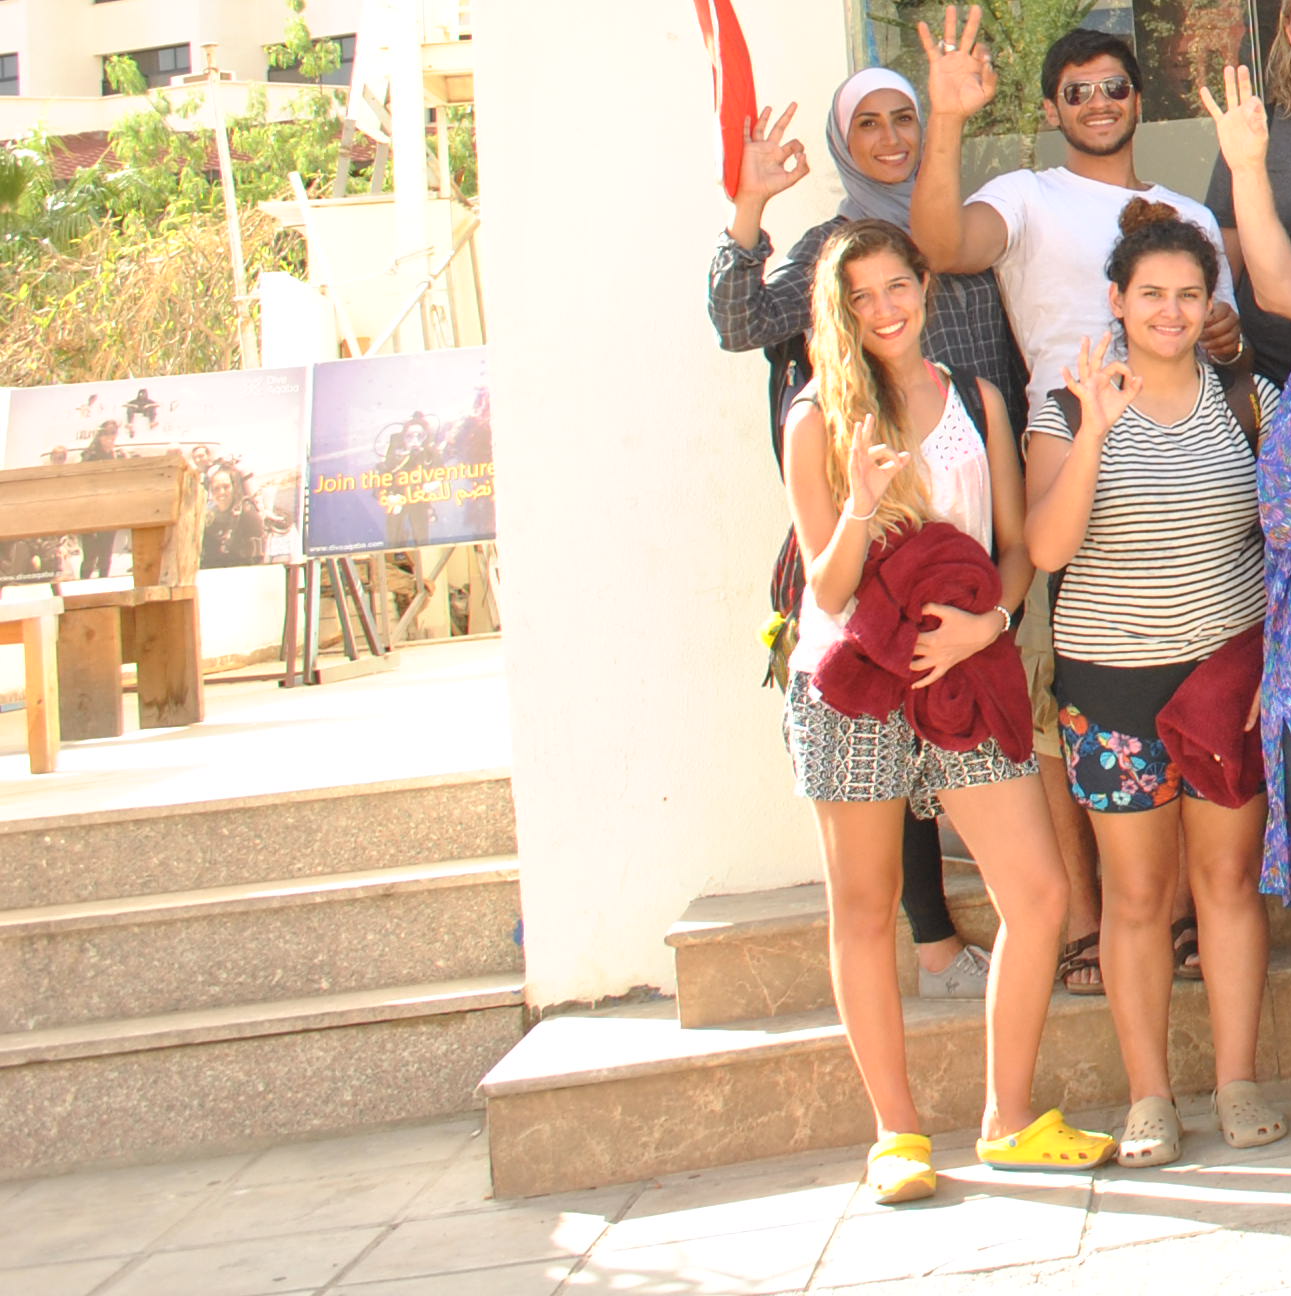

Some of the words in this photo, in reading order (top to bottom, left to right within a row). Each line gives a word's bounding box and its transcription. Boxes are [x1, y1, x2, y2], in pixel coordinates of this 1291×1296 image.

[314, 473, 356, 494] Join
[361, 471, 393, 489] the
[399, 460, 496, 488] adventure
